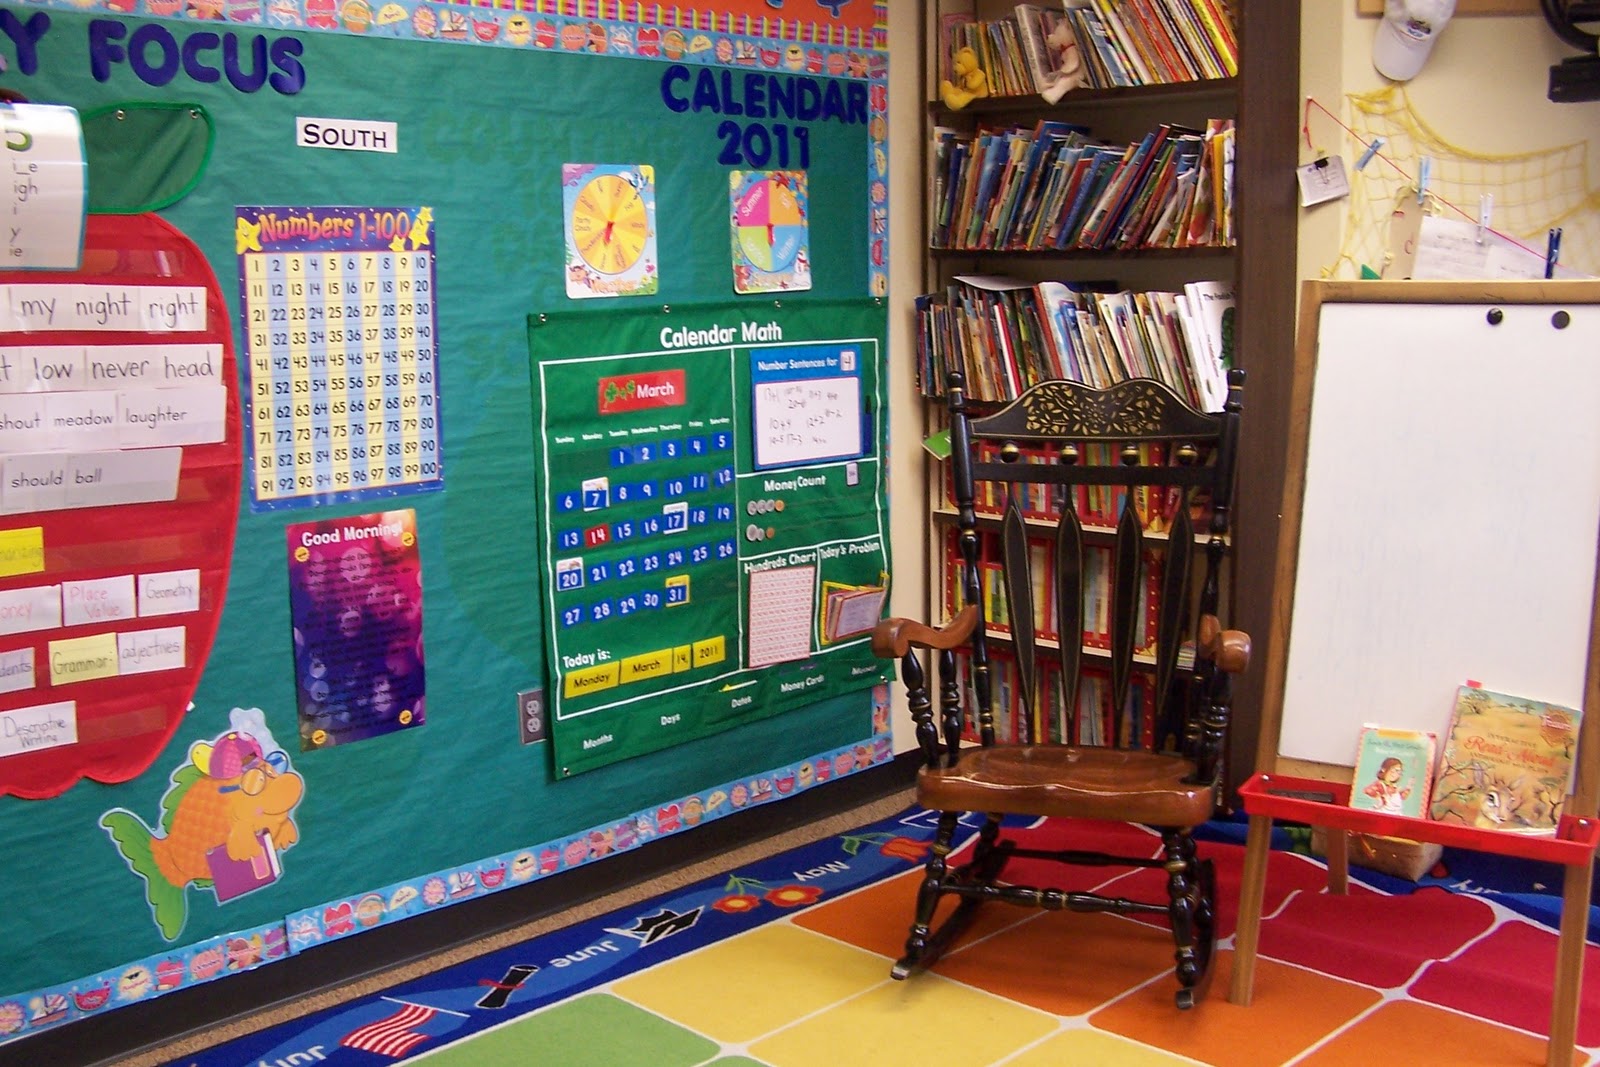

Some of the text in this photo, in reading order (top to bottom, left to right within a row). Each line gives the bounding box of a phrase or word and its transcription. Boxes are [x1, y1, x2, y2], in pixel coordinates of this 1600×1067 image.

[88, 19, 306, 95] FOCUS
[660, 64, 869, 124] CALENDAR
[303, 123, 388, 148] SOUTH
[716, 120, 810, 169] 2011
[14, 178, 38, 202] igh
[10, 227, 21, 243] y
[258, 212, 410, 242] Numbers 1-100
[272, 259, 281, 272] 2
[292, 258, 300, 272] 3
[309, 258, 319, 271] 4
[329, 258, 337, 271] 5
[347, 258, 355, 271] 6
[365, 257, 373, 270] 7
[383, 257, 391, 270] 8
[400, 257, 408, 269] 9
[416, 257, 426, 268] 10
[21, 298, 56, 325] my
[76, 292, 131, 325] night
[149, 293, 199, 329] right
[254, 303, 429, 321] 21 22 23 24 25 26 27 28 29 30
[660, 321, 782, 348] Calendar Math
[33, 357, 74, 380] low
[91, 359, 150, 380] never
[164, 350, 215, 379] head
[256, 349, 431, 370] 41 42 43 44 45 46 47 48 49 50
[758, 360, 789, 371] Number
[789, 358, 826, 369] Sentences
[827, 357, 838, 366] for
[637, 382, 675, 400] March
[53, 409, 114, 427] meadow
[126, 407, 188, 429] laughter
[259, 395, 432, 419] 61 62 63 64 65 66 67 68 69 70
[0, 413, 41, 430] shout
[619, 435, 726, 464] 1 2 3 4 5
[11, 470, 64, 488] should
[75, 468, 102, 485] ball
[262, 462, 437, 491] 91 92 93 94 95 96 97 98 99 100
[764, 475, 827, 492] Money Count
[565, 469, 731, 509] 6 7 8 9 10 11 12
[301, 521, 404, 546] Good Morning!
[564, 507, 730, 547] 13 14 15 16 17 18 19
[562, 543, 733, 588] 20 21 22 23 24 25 26
[744, 551, 817, 574] Hundreds Chart
[70, 586, 107, 601] Place
[84, 603, 120, 618] Value
[565, 588, 682, 625] 27 28 29 30 31
[122, 634, 180, 664] adjectives
[562, 649, 612, 669] Today is:
[52, 652, 113, 675] Grammar:
[573, 673, 610, 688] Monday
[632, 660, 661, 674] March
[699, 645, 718, 659] 2011
[660, 713, 681, 726] Days
[583, 733, 614, 750] Months
[793, 861, 850, 881] May
[549, 940, 619, 968] June
